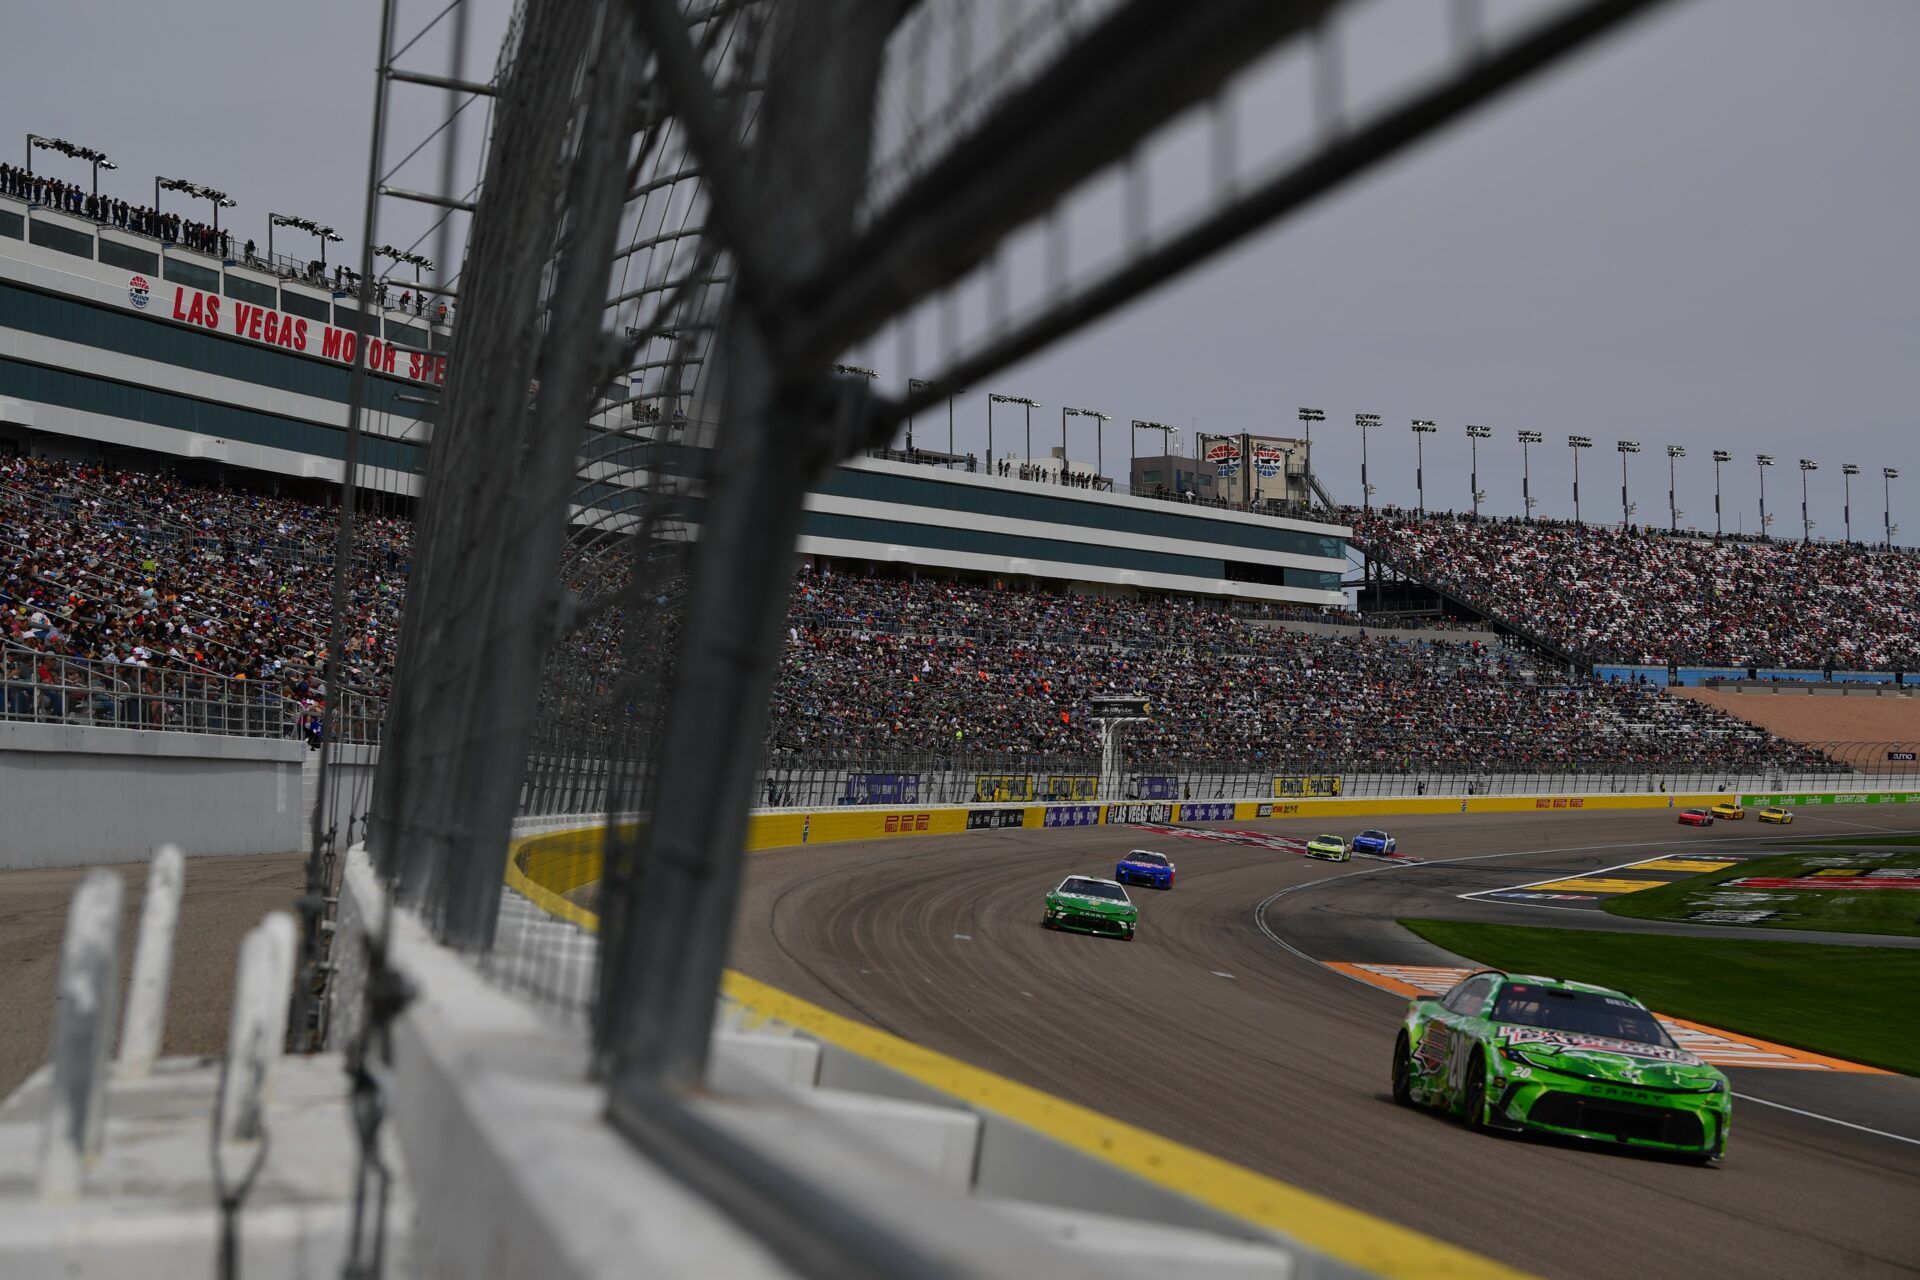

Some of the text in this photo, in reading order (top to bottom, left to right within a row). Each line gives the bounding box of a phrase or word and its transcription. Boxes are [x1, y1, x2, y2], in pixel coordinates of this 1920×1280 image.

[172, 287, 221, 329] LAS
[234, 302, 308, 351] VEGAS
[409, 351, 447, 385] SPE
[1114, 805, 1127, 823] LAS
[1128, 805, 1148, 823] VEGAS
[1151, 804, 1164, 822] USA
[1511, 1066, 1532, 1079] 20
